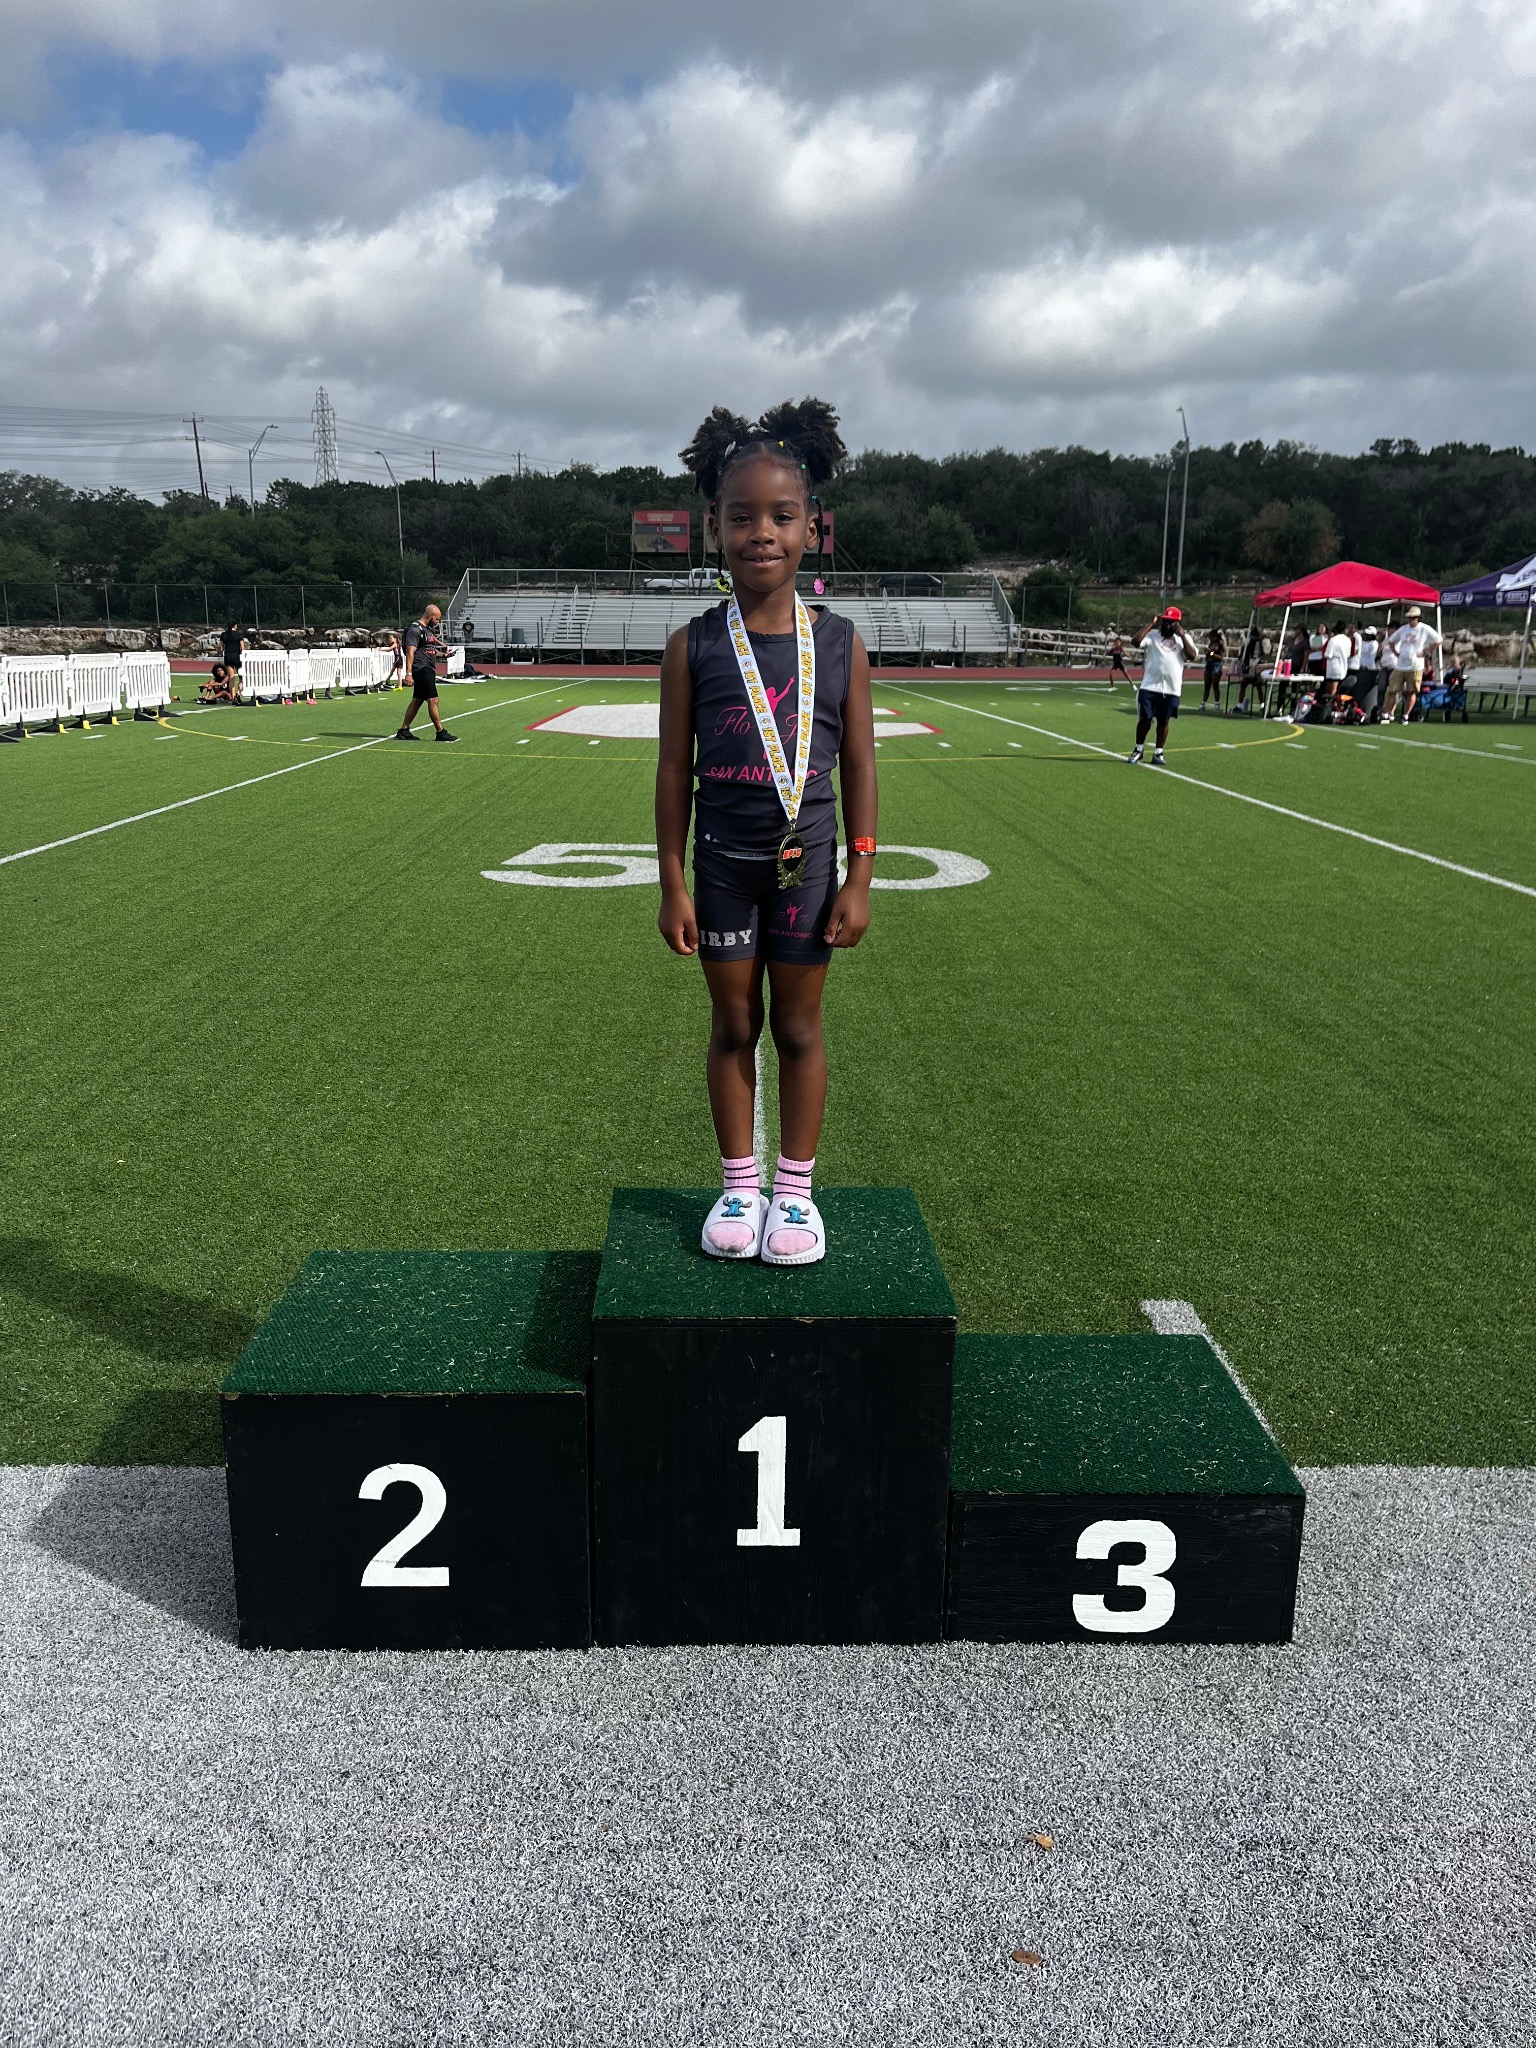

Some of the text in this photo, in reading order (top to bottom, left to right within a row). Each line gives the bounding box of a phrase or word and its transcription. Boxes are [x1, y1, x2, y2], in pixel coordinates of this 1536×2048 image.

[733, 630, 750, 657] PLACE
[743, 669, 768, 715] 1ST PLACE
[801, 649, 813, 697] 1ST PLACE
[762, 727, 786, 773] 1ST PLACE
[799, 710, 811, 760] 1ST PLACE
[780, 930, 813, 939] ANTONIO
[737, 1416, 800, 1547] 1
[359, 1463, 450, 1587] 2
[1073, 1520, 1177, 1634] 3
